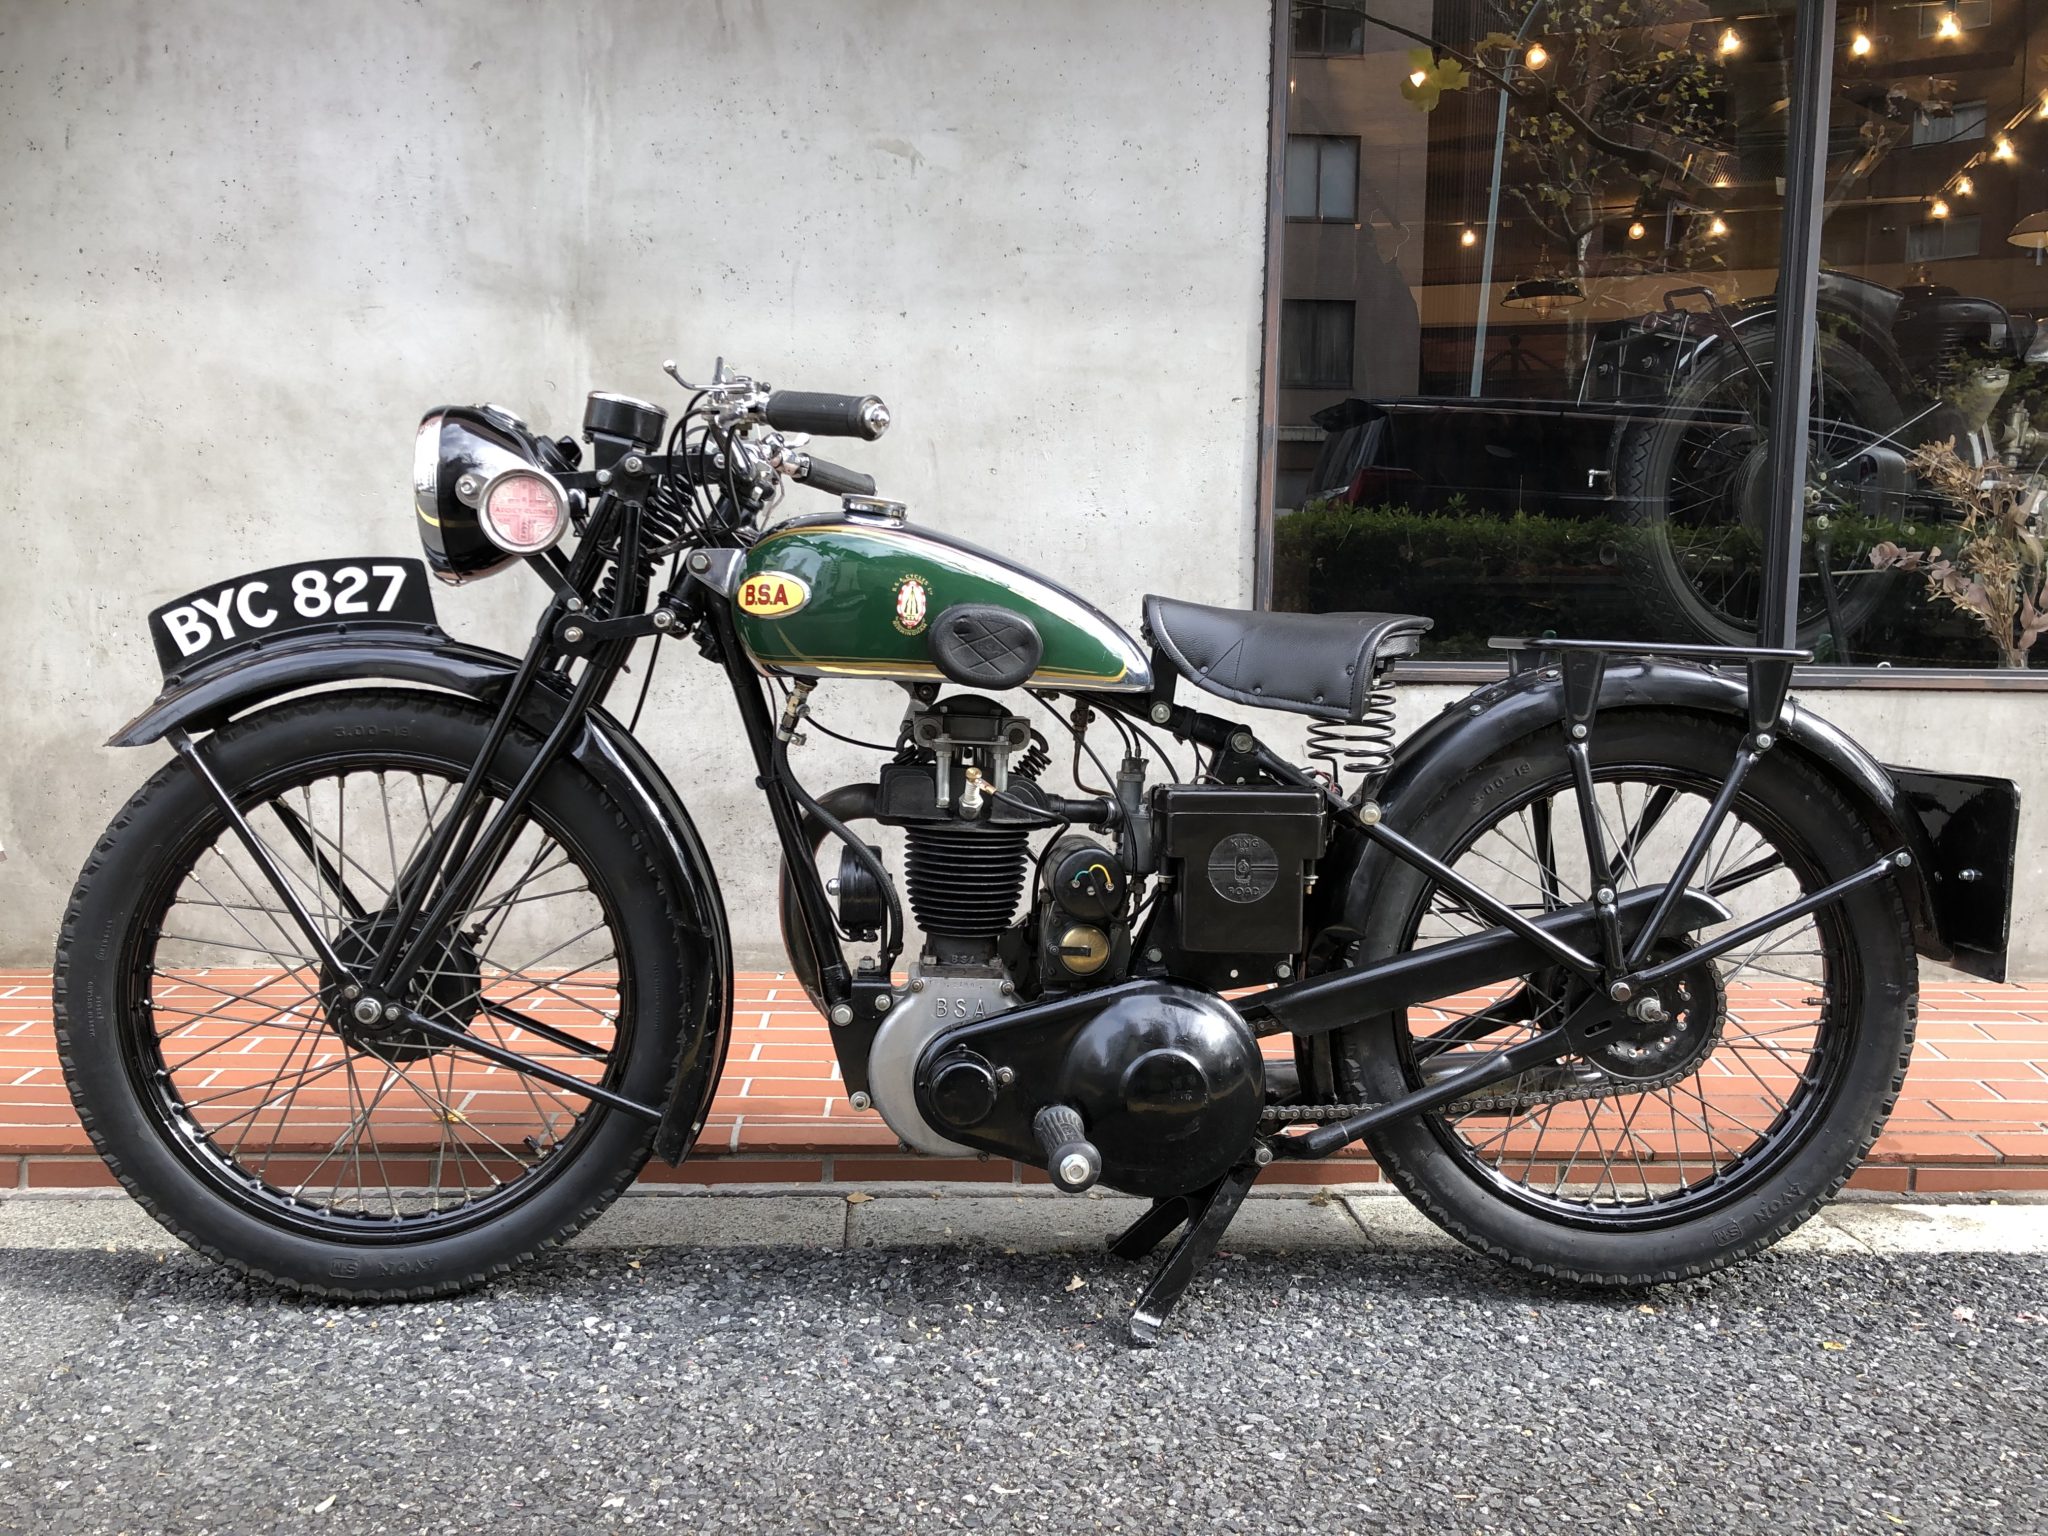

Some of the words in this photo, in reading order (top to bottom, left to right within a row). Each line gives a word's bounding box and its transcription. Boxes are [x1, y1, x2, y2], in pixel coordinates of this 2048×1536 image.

[161, 581, 278, 657] BYC
[291, 565, 407, 618] 827
[1230, 838, 1260, 848] KING
[1227, 886, 1261, 896] ROAD
[951, 954, 976, 964] BSA
[936, 997, 985, 1018] BSA
